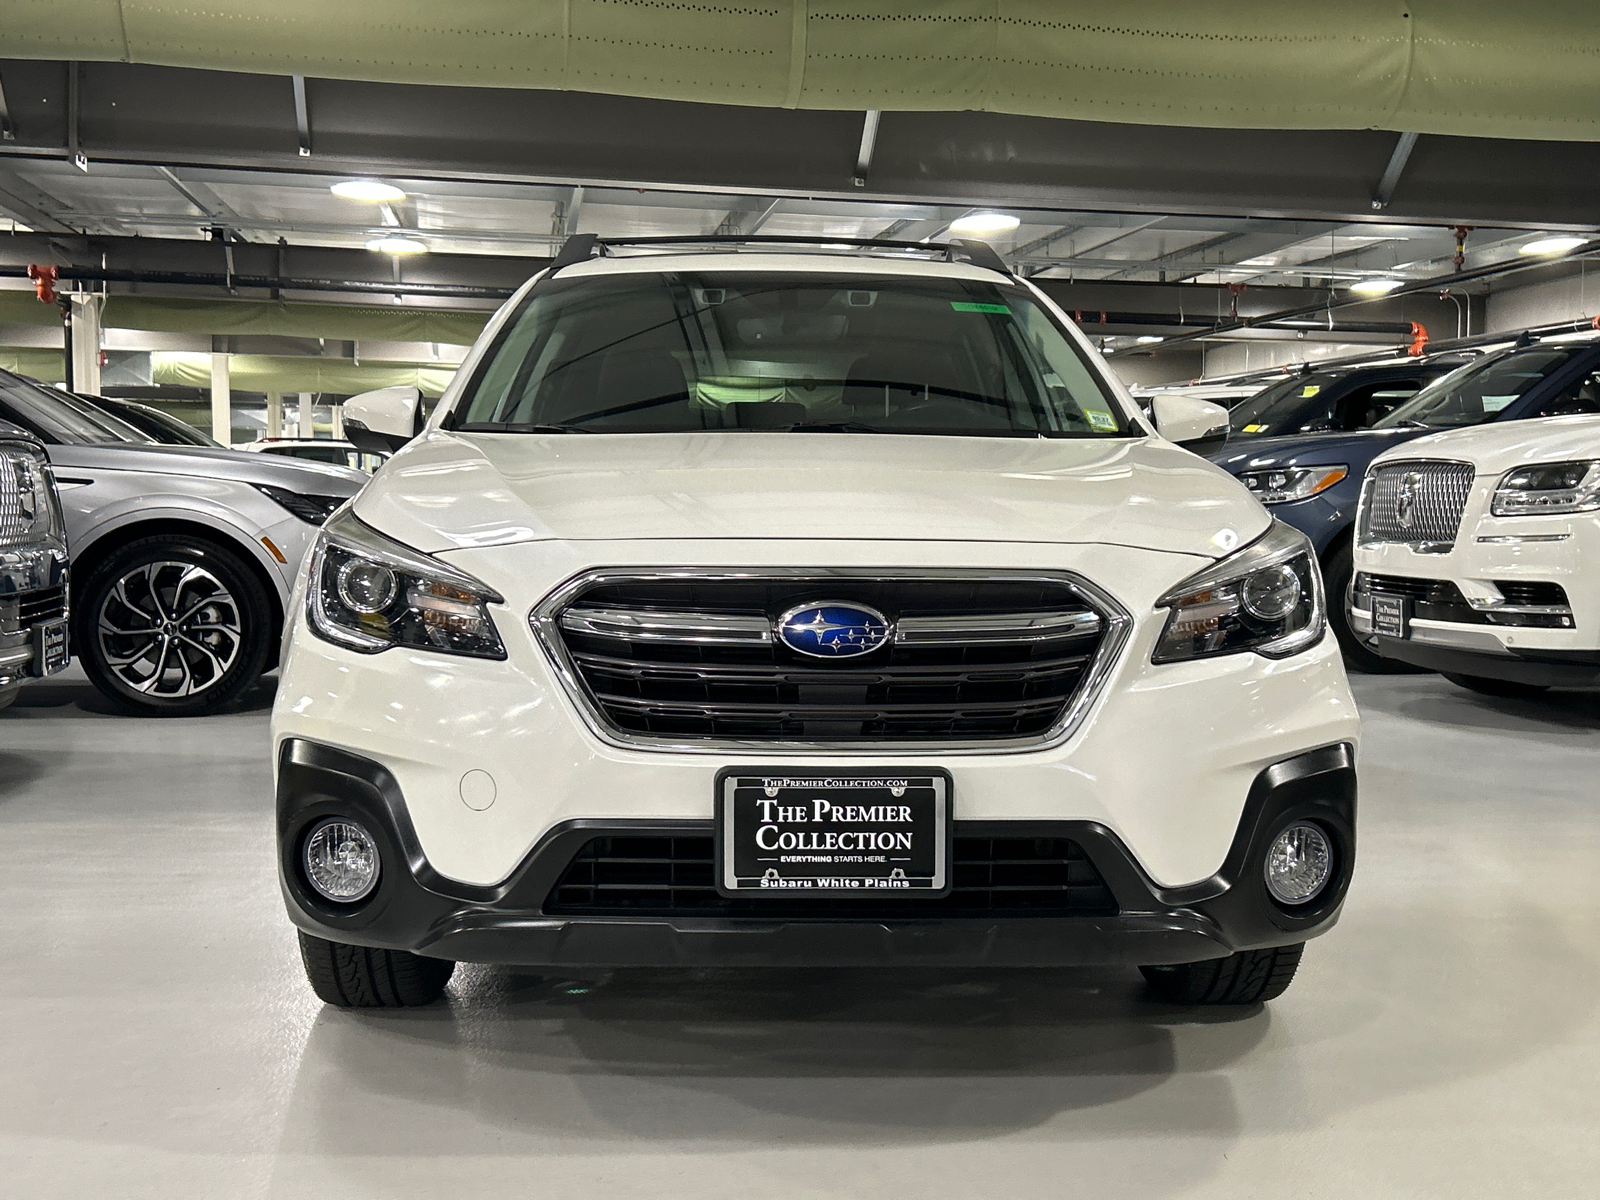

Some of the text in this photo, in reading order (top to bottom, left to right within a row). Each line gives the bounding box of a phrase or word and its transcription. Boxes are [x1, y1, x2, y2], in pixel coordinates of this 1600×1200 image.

[756, 799, 914, 823] THE PREMIER
[755, 825, 914, 850] COLLECTION
[780, 855, 888, 863] EVERYTHING STARTS HERE.
[760, 878, 910, 888] Subaru White Plains
